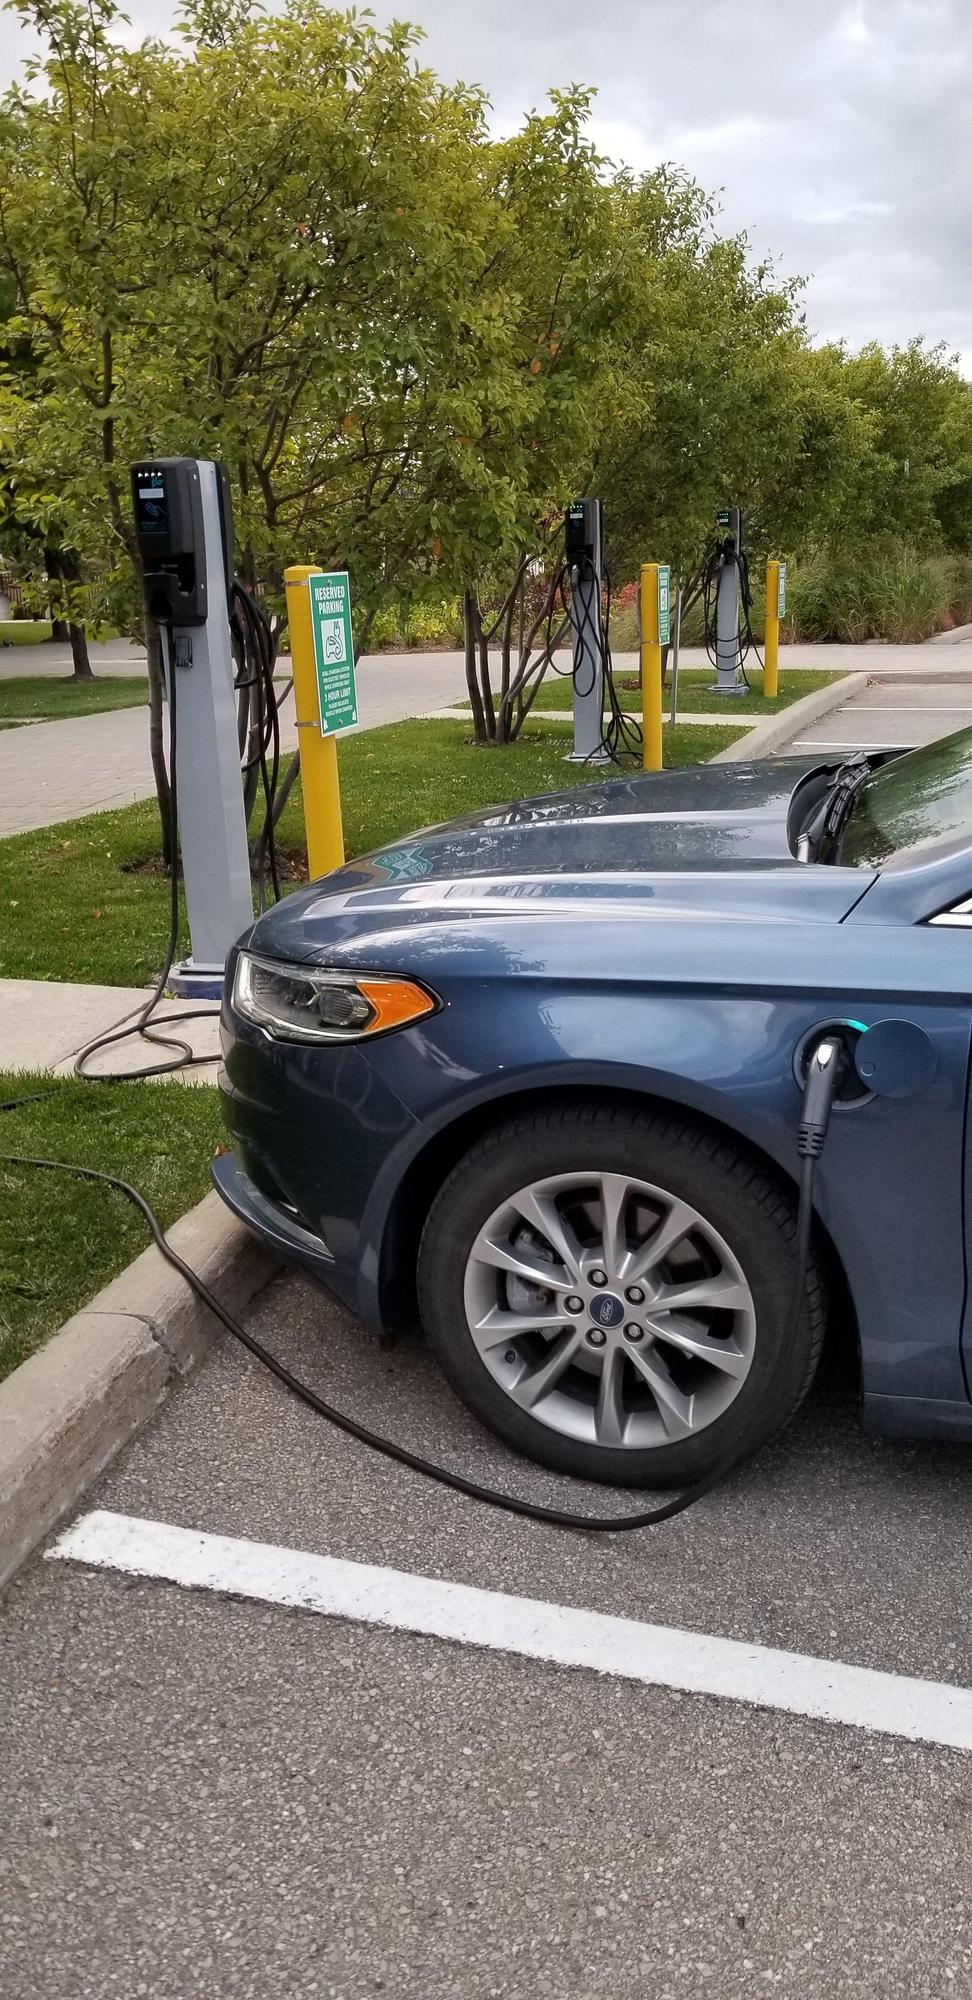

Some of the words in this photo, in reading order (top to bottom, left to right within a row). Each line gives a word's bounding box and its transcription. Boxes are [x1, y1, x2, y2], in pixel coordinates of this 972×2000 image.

[315, 586, 345, 600] RESERVED
[319, 600, 344, 615] PARKING
[328, 690, 340, 701] HOUR
[341, 687, 351, 698] LIMIT
[602, 1302, 611, 1320] Ford
